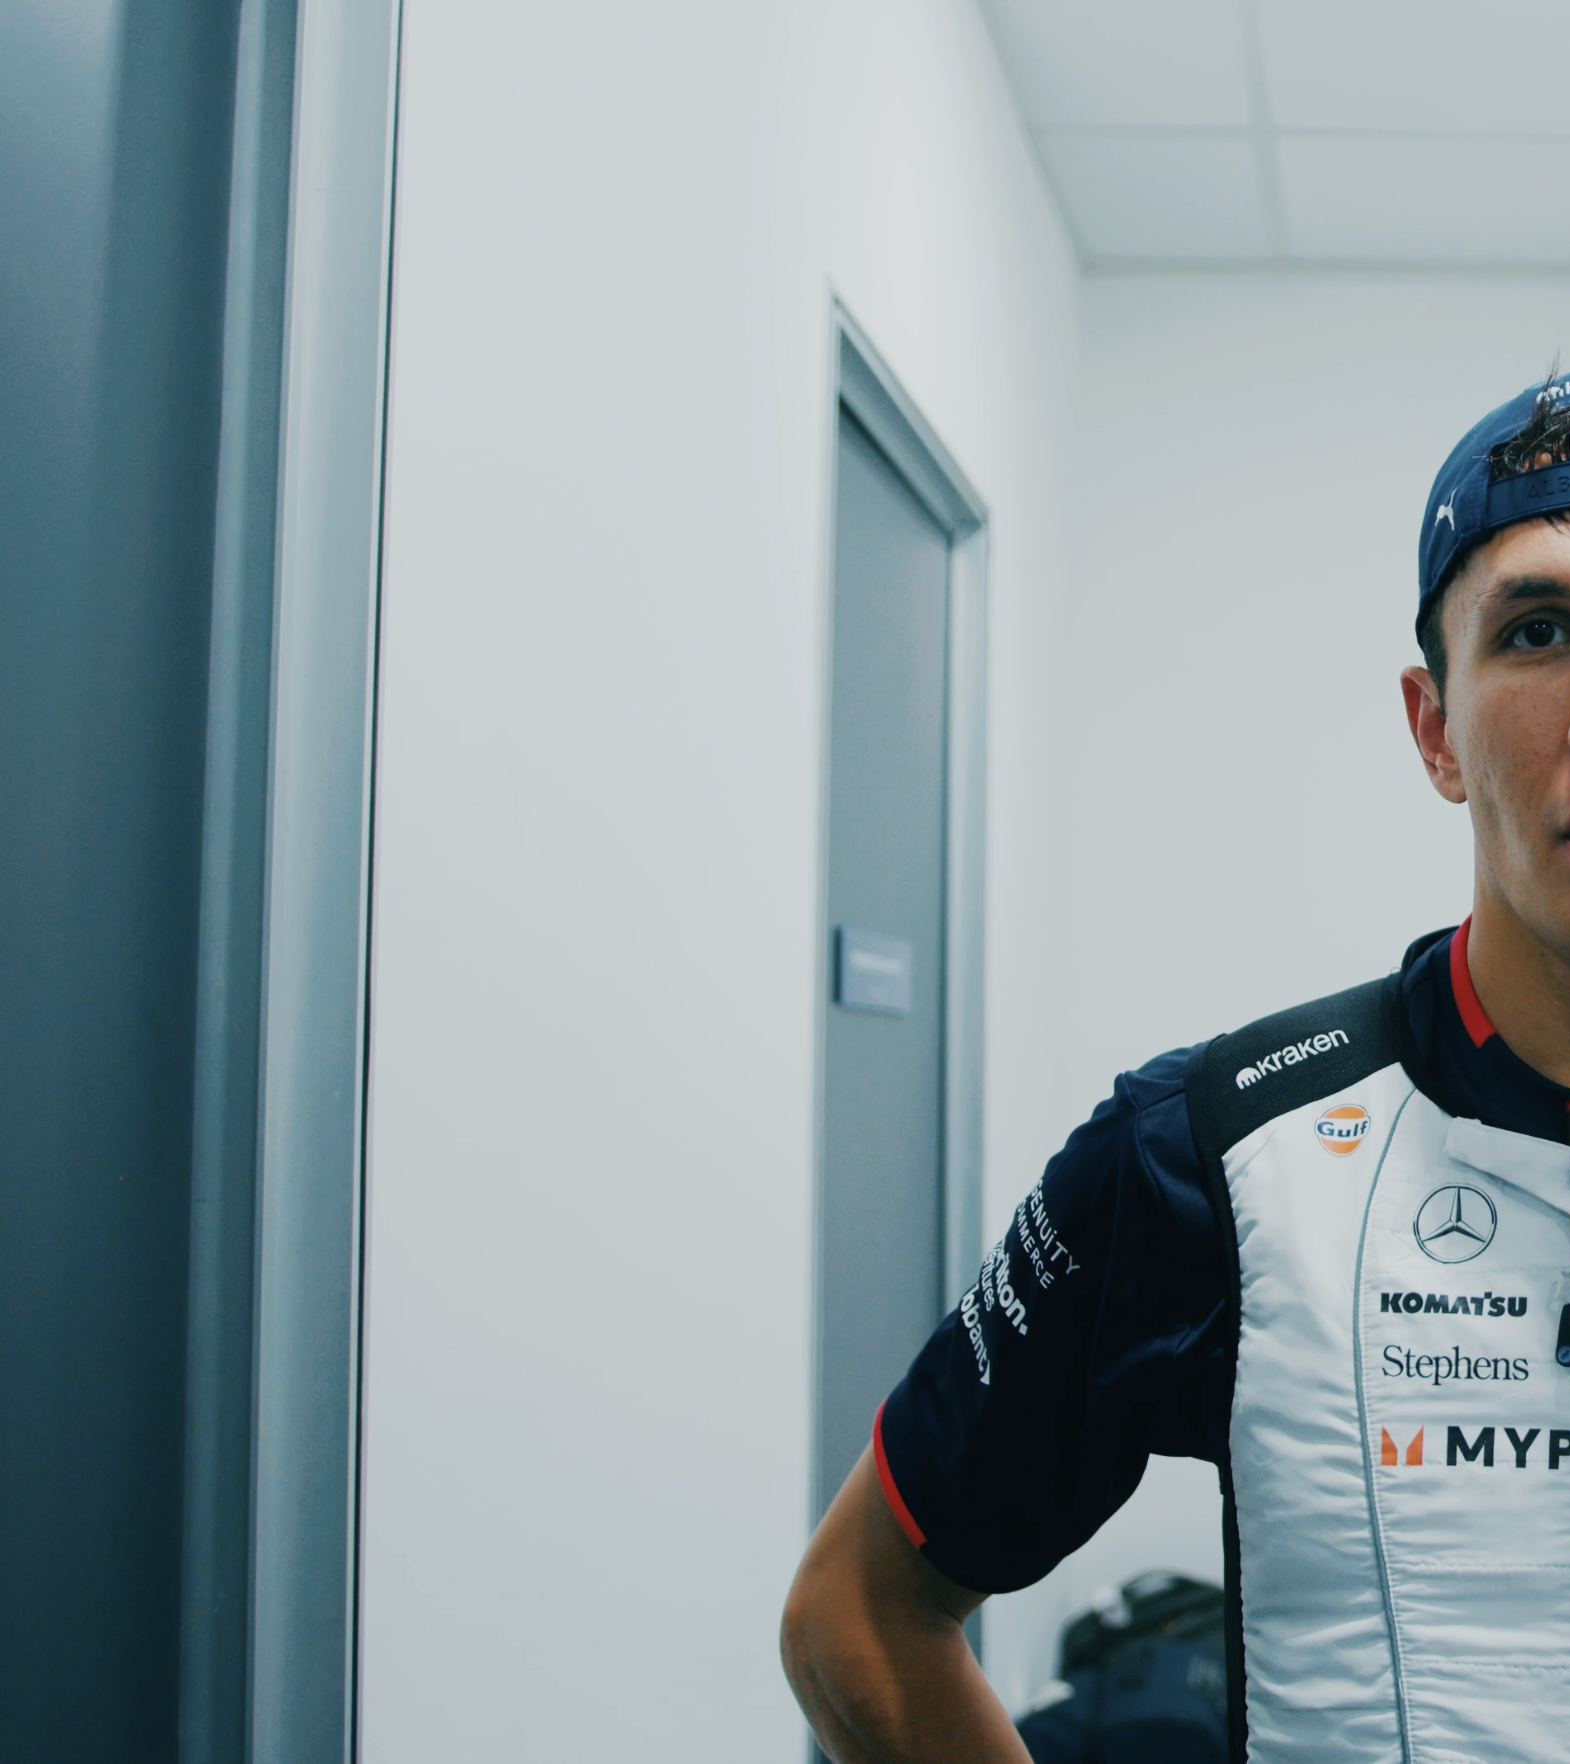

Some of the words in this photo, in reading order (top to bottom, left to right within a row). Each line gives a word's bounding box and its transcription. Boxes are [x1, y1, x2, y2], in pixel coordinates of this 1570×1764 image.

[1317, 1120, 1369, 1138] Gulf
[1016, 1199, 1055, 1289] OMMERCE
[1030, 1178, 1081, 1275] GENUiTY
[1380, 1291, 1528, 1317] KOMATSU
[1382, 1344, 1529, 1386] Stephens
